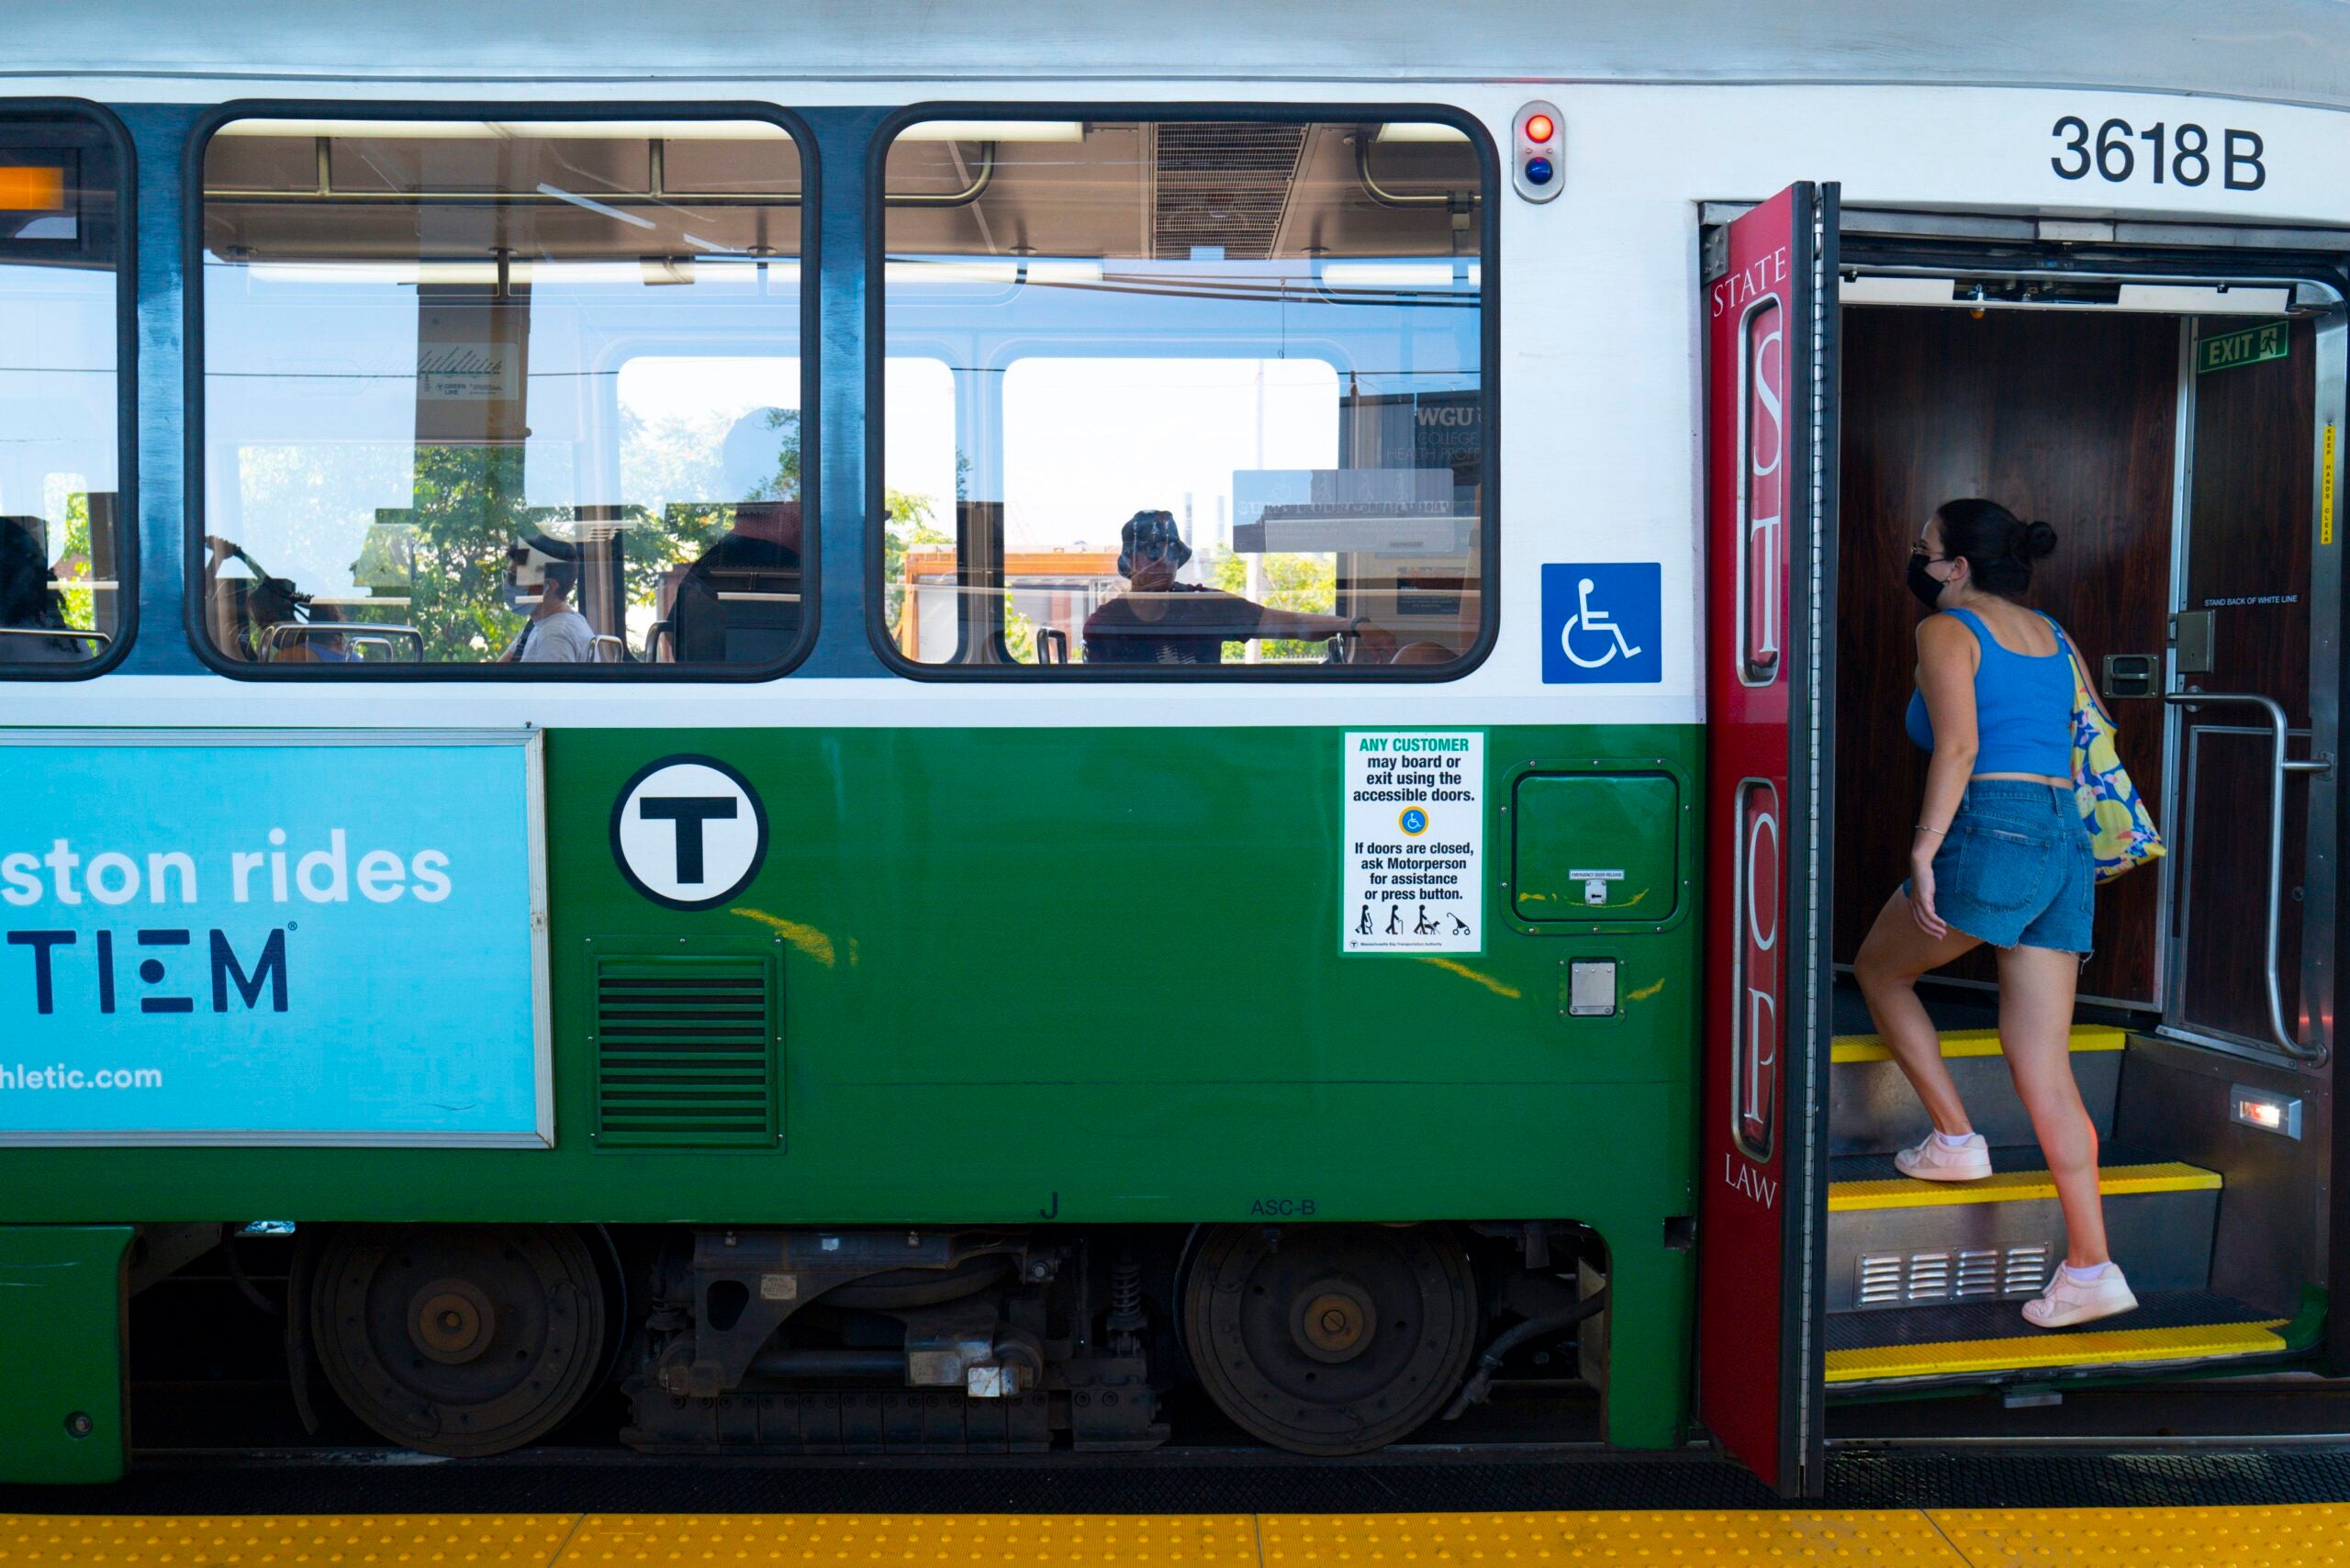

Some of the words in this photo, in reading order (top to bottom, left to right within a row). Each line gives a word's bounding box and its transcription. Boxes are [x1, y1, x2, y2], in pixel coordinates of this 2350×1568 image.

[1713, 246, 1786, 317] STATE
[2209, 333, 2254, 364] EXIT
[1416, 407, 1474, 427] WGU
[2204, 599, 2226, 607] STAND
[2227, 598, 2246, 606] BACK
[2246, 597, 2257, 605] OF
[2257, 596, 2280, 604] WHITE
[2281, 595, 2299, 603] LINE
[1359, 738, 1388, 752] ANY
[1393, 738, 1469, 752] CUSTOMER
[1367, 756, 1397, 771] may
[1401, 755, 1442, 768] board
[1446, 756, 1461, 768] or
[1366, 771, 1393, 785] exit
[1396, 771, 1435, 788] using
[1438, 771, 1461, 785] the
[1353, 789, 1427, 801] accessible
[1431, 789, 1475, 801] doors.
[640, 797, 737, 883] T
[1355, 842, 1363, 854] If
[1367, 842, 1403, 854] doors
[1405, 844, 1427, 854] are
[1429, 842, 1474, 857] closed,
[1, 838, 197, 906] ston
[231, 827, 453, 903] rides
[1361, 857, 1383, 869] ask
[1387, 857, 1467, 872] Motorperson
[1370, 872, 1388, 884] for
[1391, 872, 1458, 884] assistance
[1364, 890, 1378, 900] or
[1381, 890, 1416, 902] press
[1419, 888, 1463, 900] button.
[0, 1062, 162, 1090] hletic.com
[1725, 1153, 1777, 1210] LAW
[1250, 1199, 1316, 1216] ASC-B
